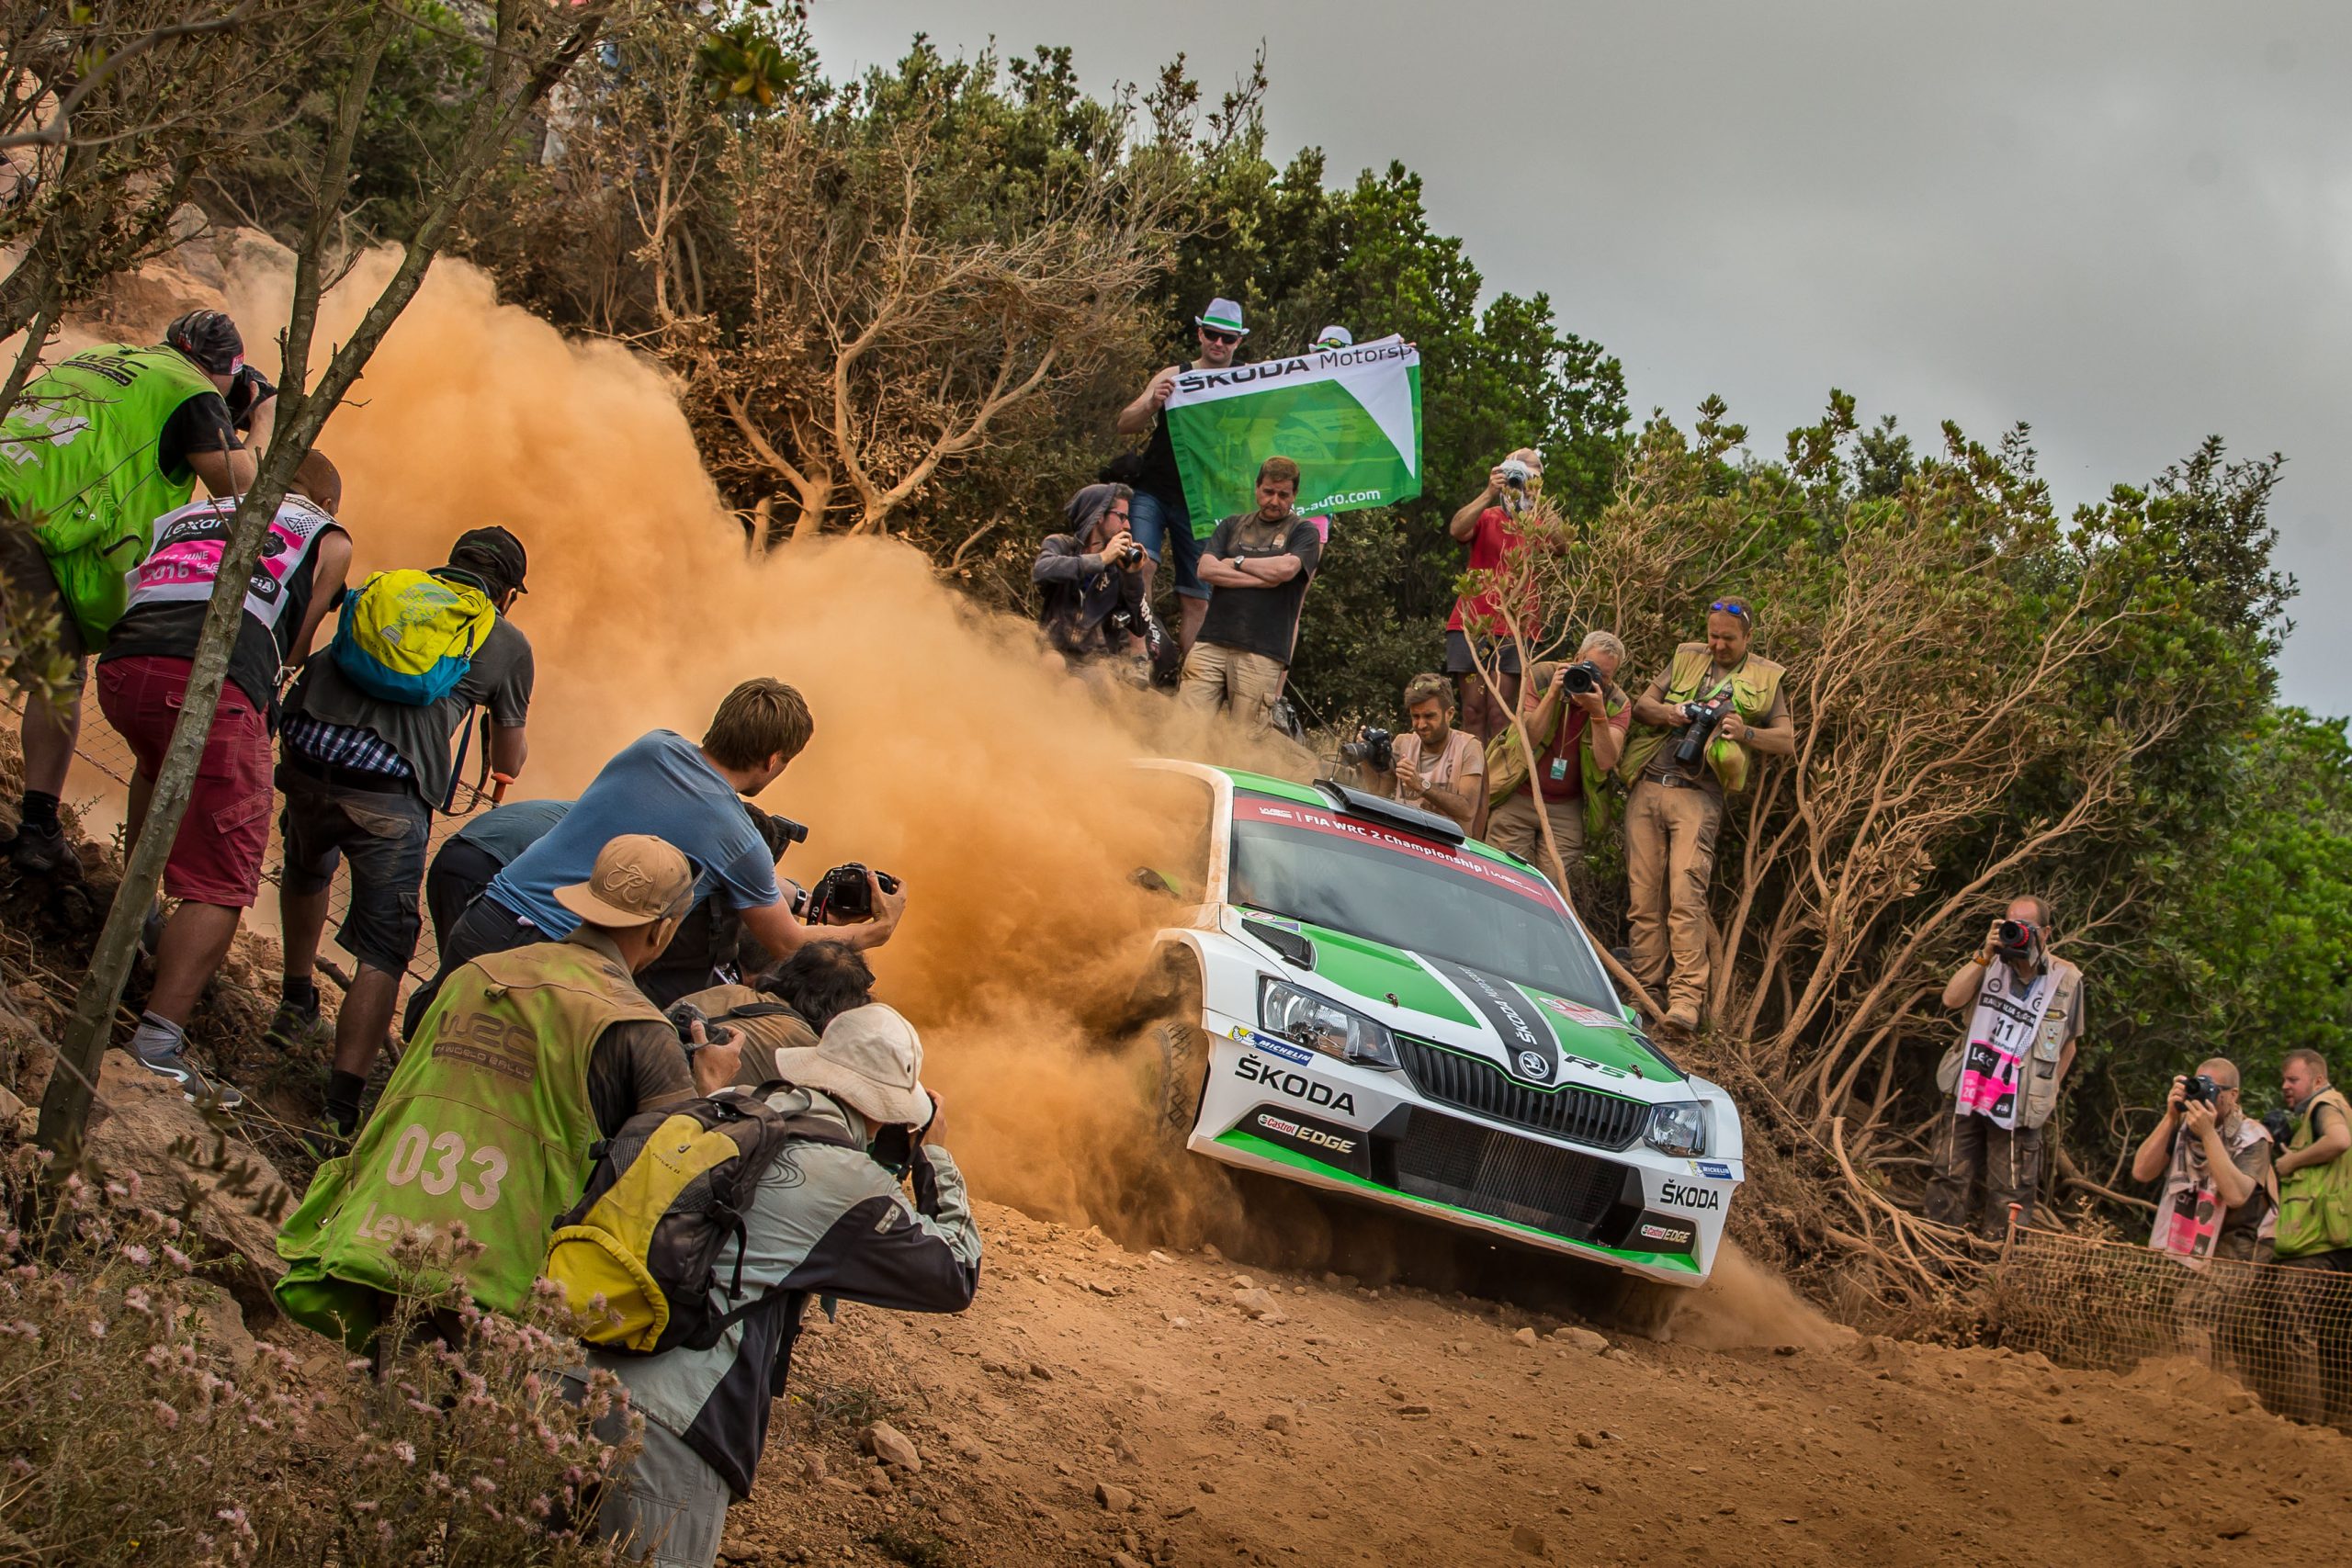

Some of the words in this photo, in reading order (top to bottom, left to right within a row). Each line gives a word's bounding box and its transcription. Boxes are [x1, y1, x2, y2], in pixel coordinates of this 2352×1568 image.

[164, 517, 230, 540] Lexar
[180, 550, 209, 561] JUNE
[251, 575, 274, 592] FIA
[1305, 814, 1330, 827] FIA
[1333, 820, 1368, 837] WRC
[1370, 829, 1382, 840] 2
[1384, 834, 1482, 873] Championship
[1494, 998, 1538, 1045] ŠKODA
[1258, 1040, 1312, 1063] MICHELIN
[1564, 1055, 1628, 1079] R5
[1234, 1054, 1356, 1118] ŠKODA
[1267, 1117, 1296, 1135] Castrol
[1296, 1126, 1358, 1155] EDGE
[386, 1123, 509, 1212] 033
[1702, 1165, 1731, 1174] MICHELIN
[1659, 1179, 1720, 1211] ŠKODA
[1646, 1226, 1665, 1238] Castrol
[1664, 1228, 1692, 1244] EDGE
